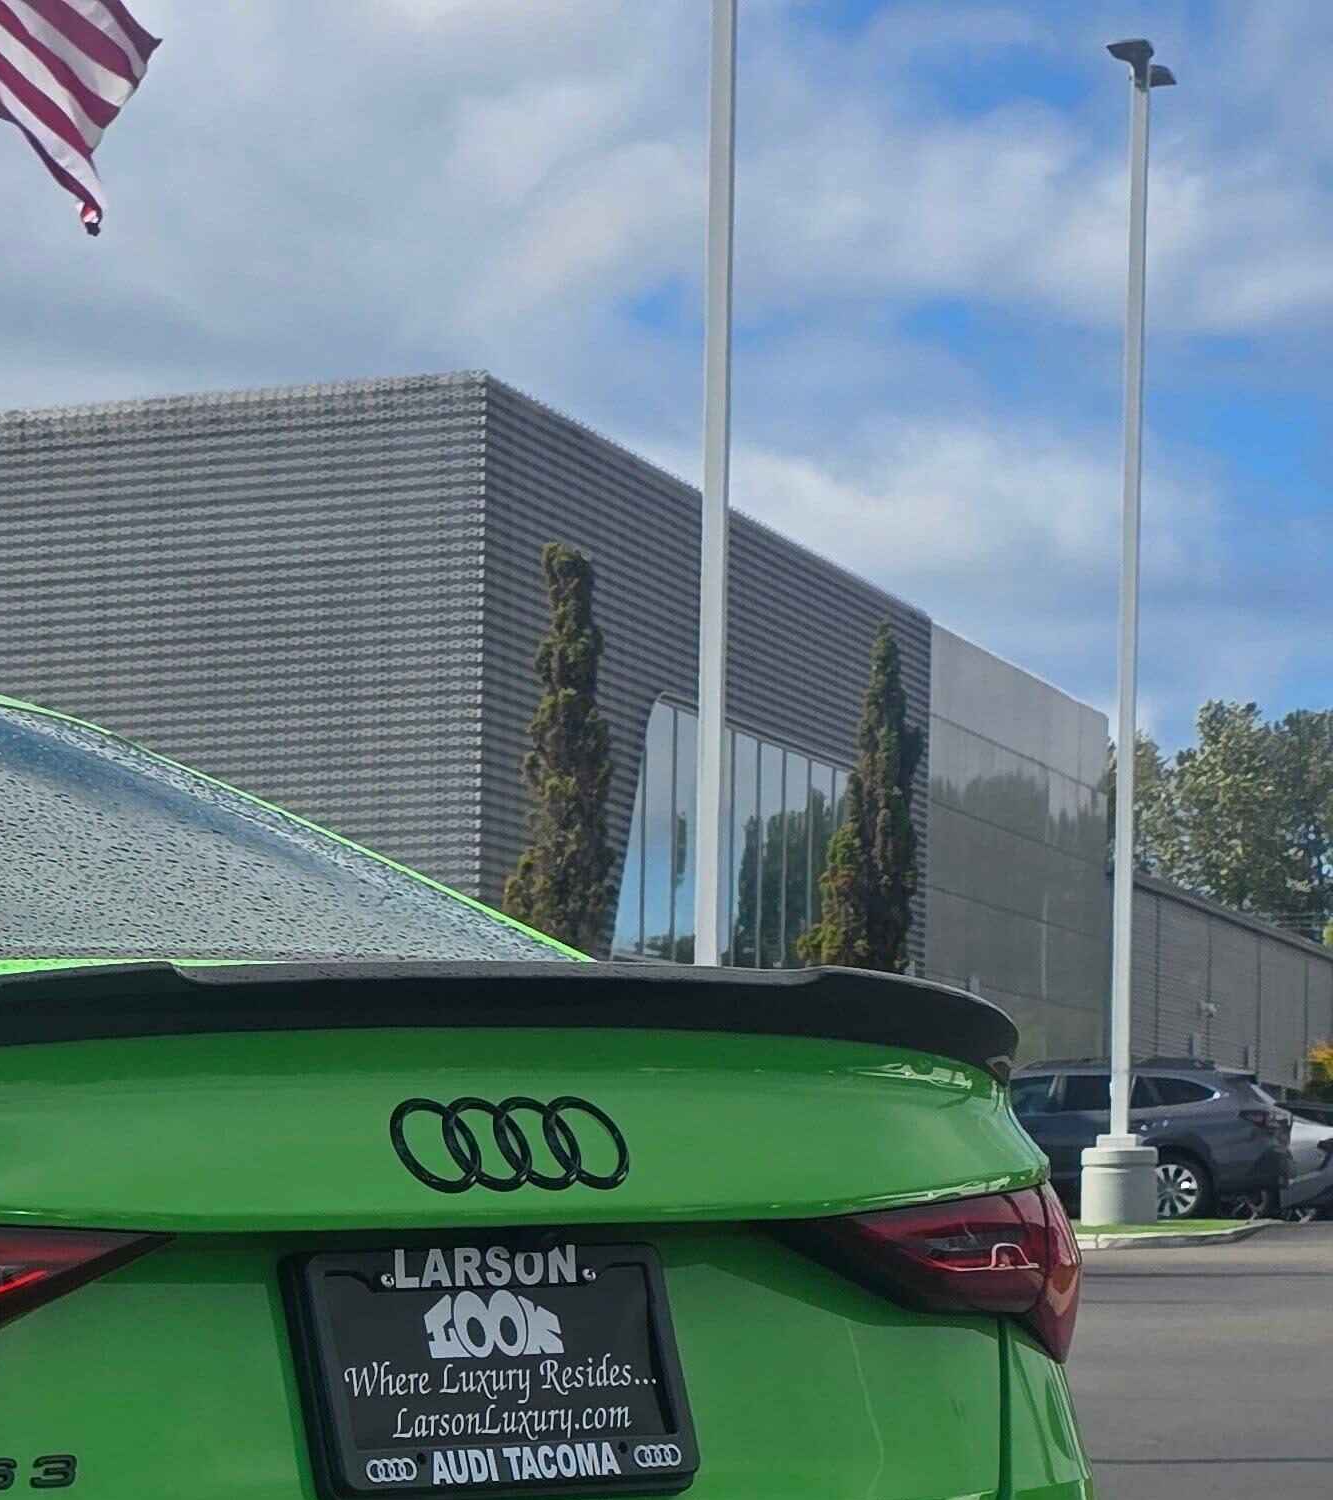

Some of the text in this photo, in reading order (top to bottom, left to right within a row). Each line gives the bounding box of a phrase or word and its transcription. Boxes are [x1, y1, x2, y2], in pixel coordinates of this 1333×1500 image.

[394, 1245, 577, 1289] LARSON
[343, 1361, 432, 1397] Where
[440, 1363, 531, 1403] Luxury
[393, 1404, 633, 1440] LarsonLuxury.com
[29, 1454, 78, 1489] 3
[433, 1442, 622, 1485] AUDI TACOMA
